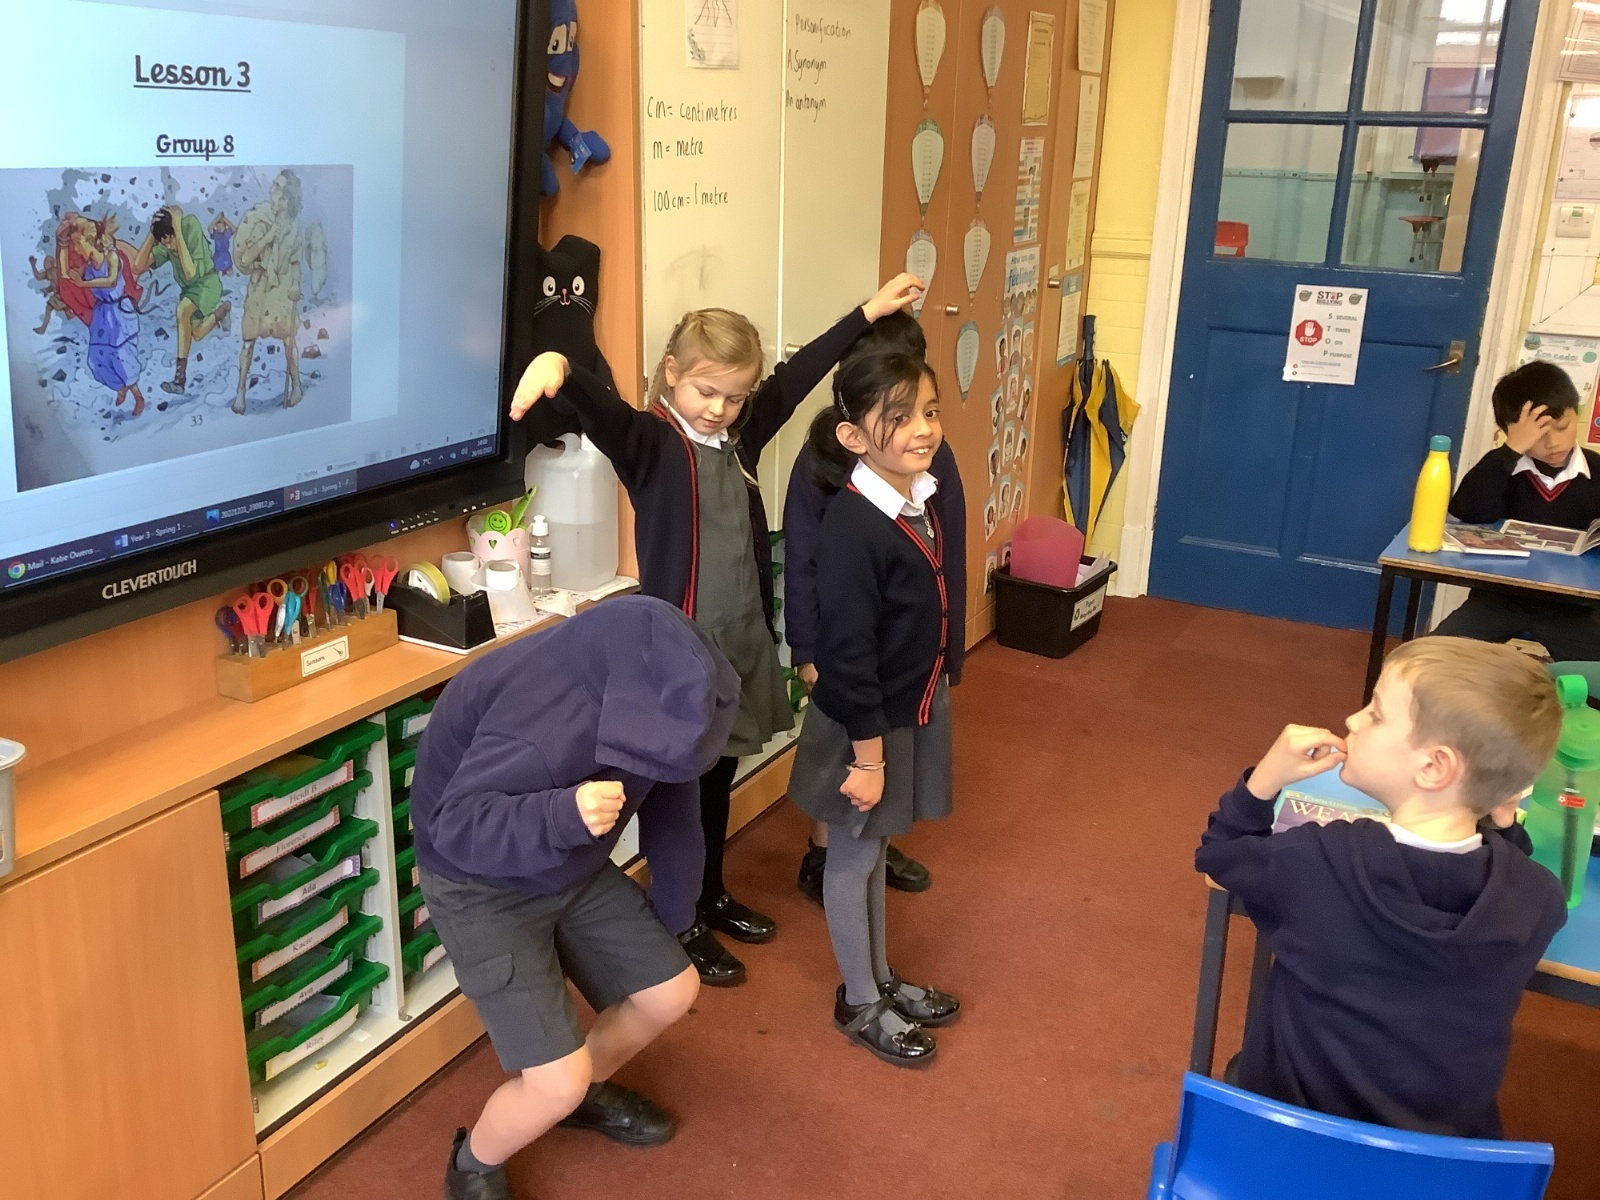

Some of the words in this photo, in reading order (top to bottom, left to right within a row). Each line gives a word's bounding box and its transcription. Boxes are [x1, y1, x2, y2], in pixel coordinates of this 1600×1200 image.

[787, 48, 793, 70] A
[135, 55, 232, 86] Lesson
[236, 61, 251, 88] 3
[680, 99, 737, 122] centimetres
[156, 134, 219, 161] Group
[223, 135, 235, 154] 8
[676, 137, 703, 157] metre
[701, 186, 728, 205] metre
[1007, 265, 1036, 293] feeling?
[191, 414, 204, 427] 33
[130, 534, 144, 543] Year
[145, 531, 150, 539] 3
[155, 526, 176, 537] Spring
[27, 560, 44, 571] Mail
[51, 554, 68, 564] Katie
[70, 548, 94, 560] Owens
[102, 559, 197, 600] CLEVERTOUCH
